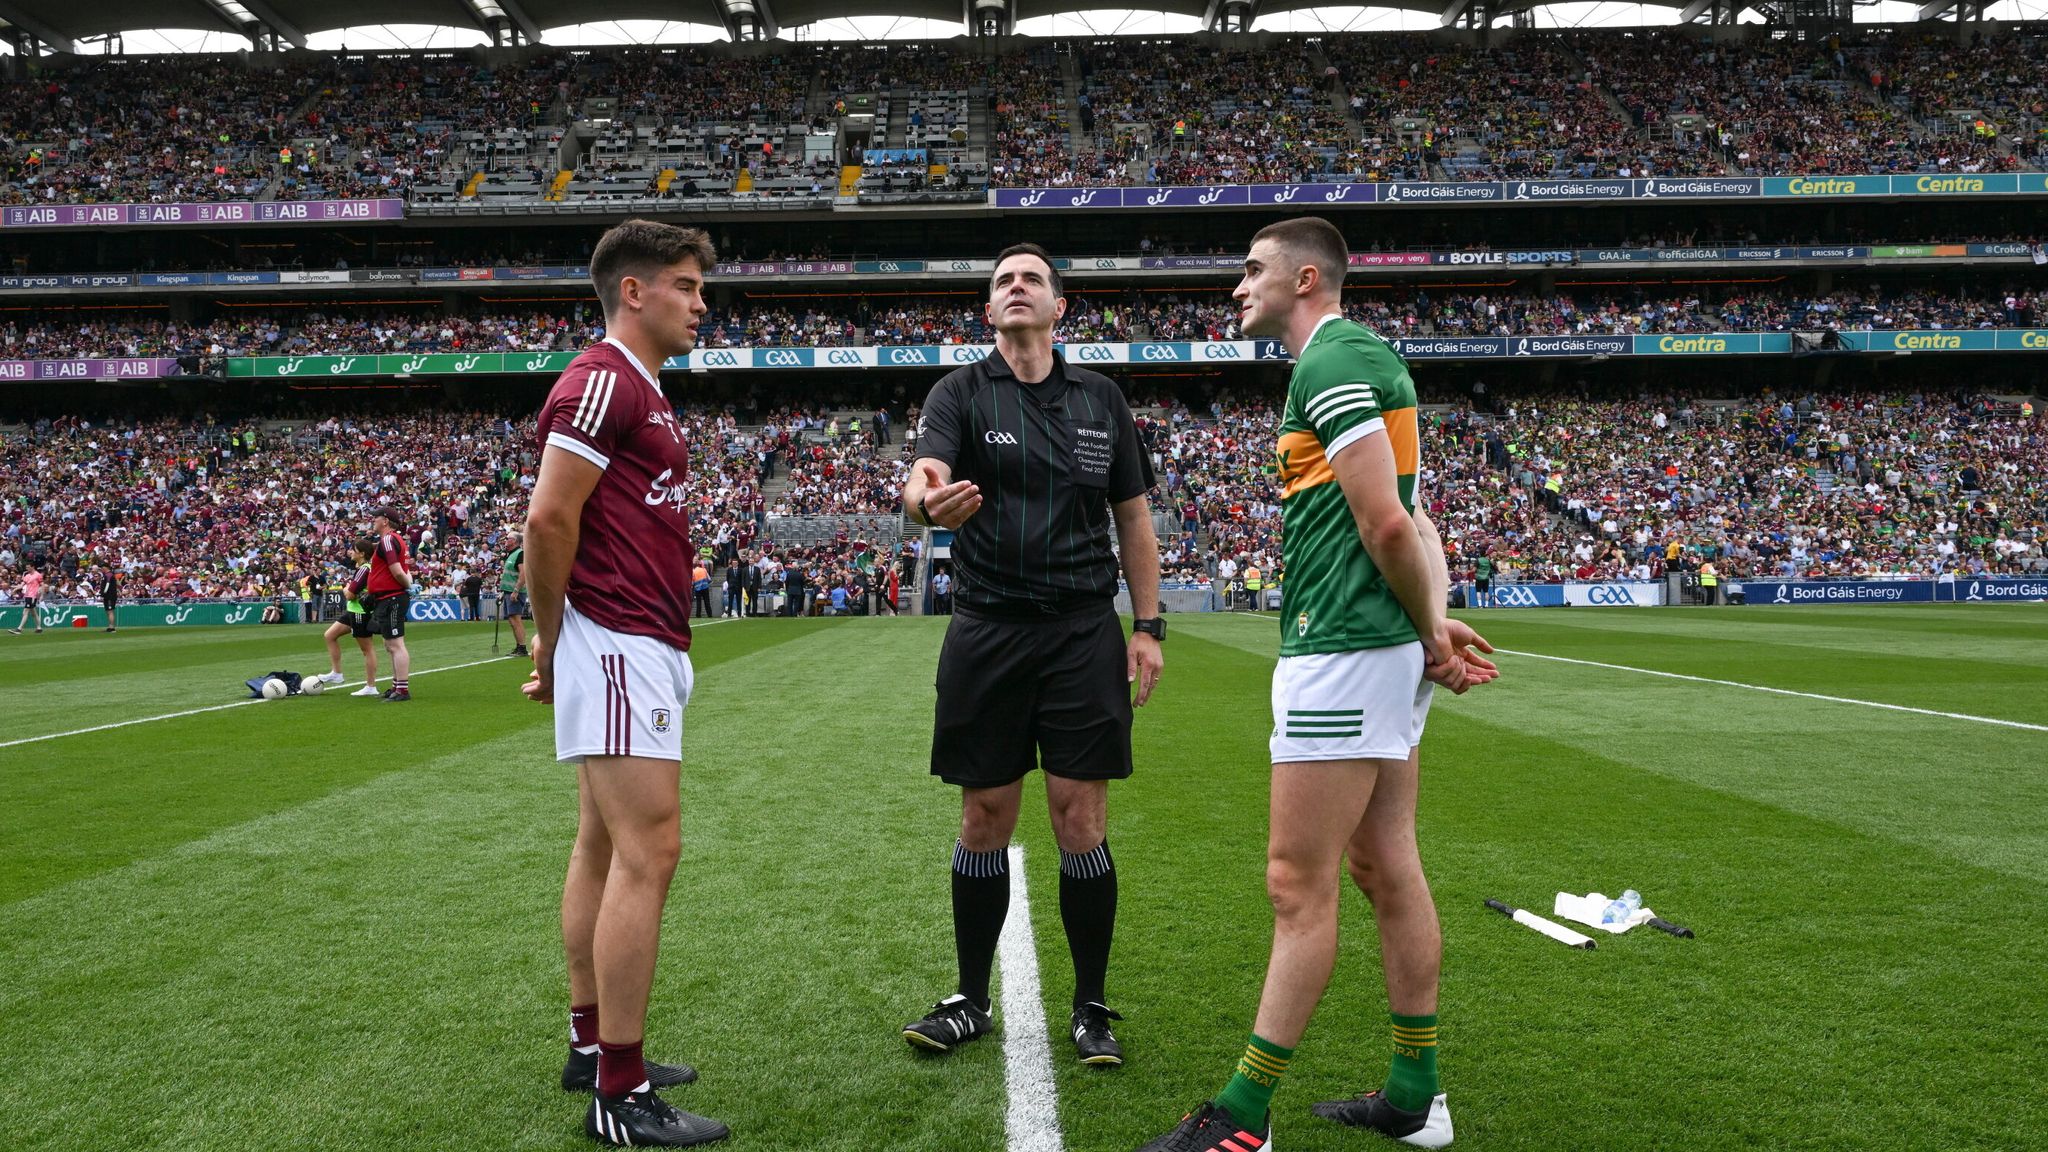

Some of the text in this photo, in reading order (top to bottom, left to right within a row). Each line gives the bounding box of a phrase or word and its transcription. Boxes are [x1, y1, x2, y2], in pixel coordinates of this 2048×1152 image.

[1532, 184, 1624, 196] Bord Gáis Energy
[1659, 182, 1752, 193] Bord Gáis Energy
[1789, 179, 1855, 194] Centra
[1917, 177, 1983, 192] Centra
[1020, 190, 1045, 207] eir
[1072, 190, 1096, 206] eir
[1148, 189, 1172, 205] eir
[1199, 188, 1223, 204] eir
[1274, 186, 1299, 202] eir
[1326, 185, 1351, 202] eir
[1403, 186, 1495, 198] Bord Gáis Energy
[29, 209, 56, 222] AIB
[91, 208, 118, 221] AIB
[153, 207, 181, 220] AIB
[215, 206, 243, 220] AIB
[279, 205, 307, 218] AIB
[342, 204, 369, 216] AIB
[1599, 252, 1631, 260] GAA.ie
[1658, 250, 1718, 259] @officialGAA
[1985, 245, 2032, 254] @CrokePa
[1096, 259, 1116, 268] GAA
[1366, 254, 1424, 264] very very very
[1451, 253, 1502, 264] BOYLE
[1506, 252, 1572, 262] SPORTS
[880, 263, 899, 271] GAA
[952, 262, 971, 270] GAA
[23, 278, 57, 288] group
[73, 276, 127, 286] kn group
[157, 275, 188, 284] Kingspan
[228, 274, 258, 282] Kingspan
[1533, 340, 1624, 351] Bord Gáis Energy
[1660, 337, 1726, 352] Centra
[1895, 332, 1961, 349] Centra
[1079, 346, 1114, 360] GAA
[1142, 346, 1178, 359] GAA
[1205, 344, 1240, 358] GAA
[1406, 342, 1498, 354] Bord Gáis Energy
[527, 354, 551, 371] eir
[703, 352, 738, 366] GAA
[766, 351, 801, 365] GAA
[828, 350, 863, 364] GAA
[891, 349, 927, 363] GAA
[60, 363, 87, 376] AIB
[121, 362, 148, 374] AIB
[278, 358, 303, 375] eir
[331, 357, 355, 373] eir
[402, 355, 427, 372] eir
[455, 355, 480, 371] eir
[985, 430, 1018, 444] GAA
[1232, 582, 1243, 591] 32
[1686, 577, 1699, 586] 33
[1495, 586, 1539, 605] GAA
[1588, 586, 1634, 604] GAA
[1793, 586, 1902, 599] Bord Gáis Energy
[1986, 583, 2048, 595] Bord Gáis
[328, 594, 340, 603] 30
[166, 607, 192, 624] eir
[225, 606, 252, 624] eir
[410, 602, 456, 620] GAA
